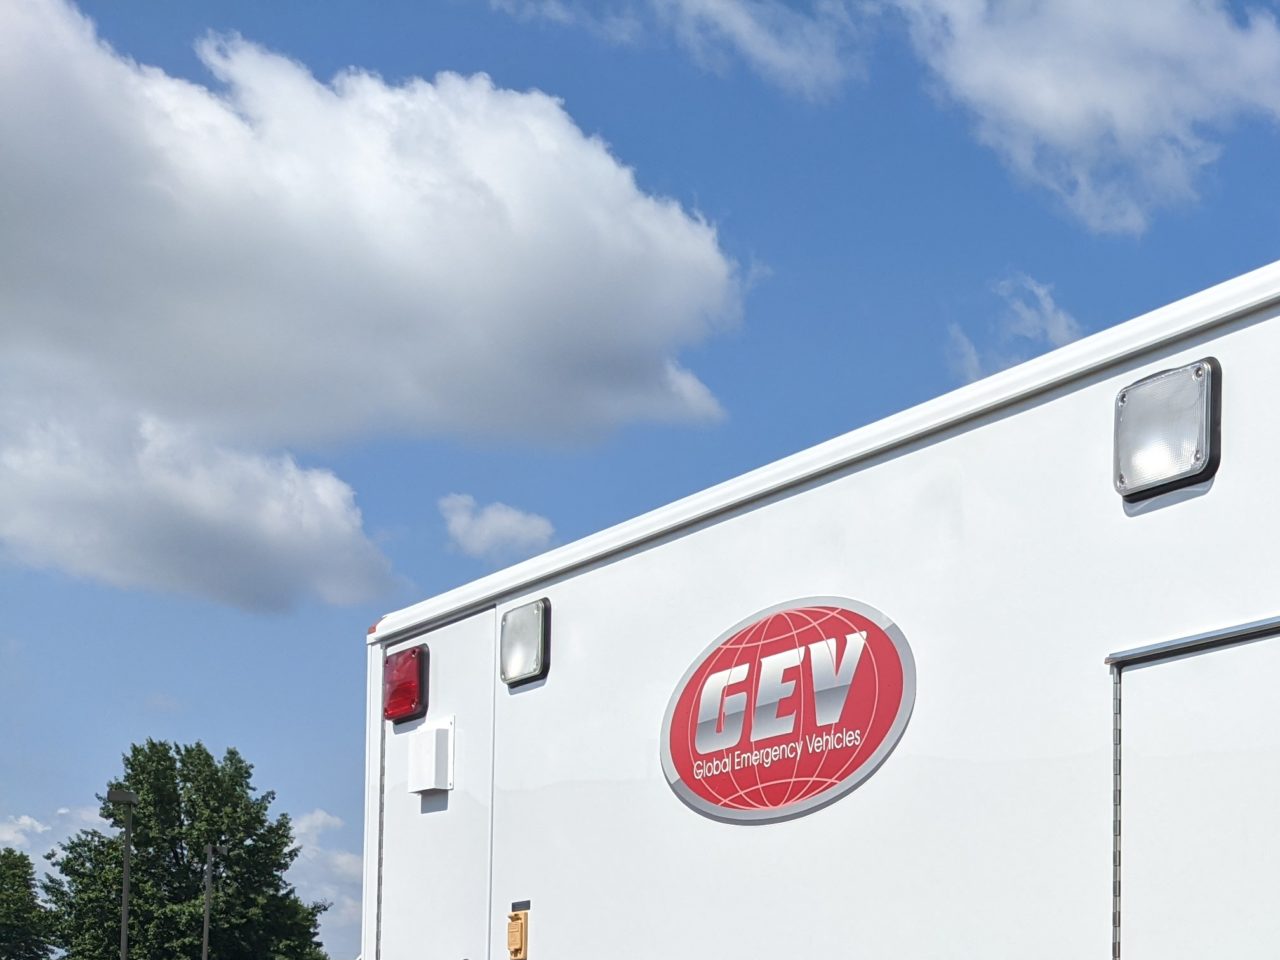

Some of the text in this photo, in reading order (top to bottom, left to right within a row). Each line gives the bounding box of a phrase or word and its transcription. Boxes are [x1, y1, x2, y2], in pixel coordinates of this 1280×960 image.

[694, 630, 868, 755] GEV
[693, 727, 861, 780] Global Emergency Vehicles
